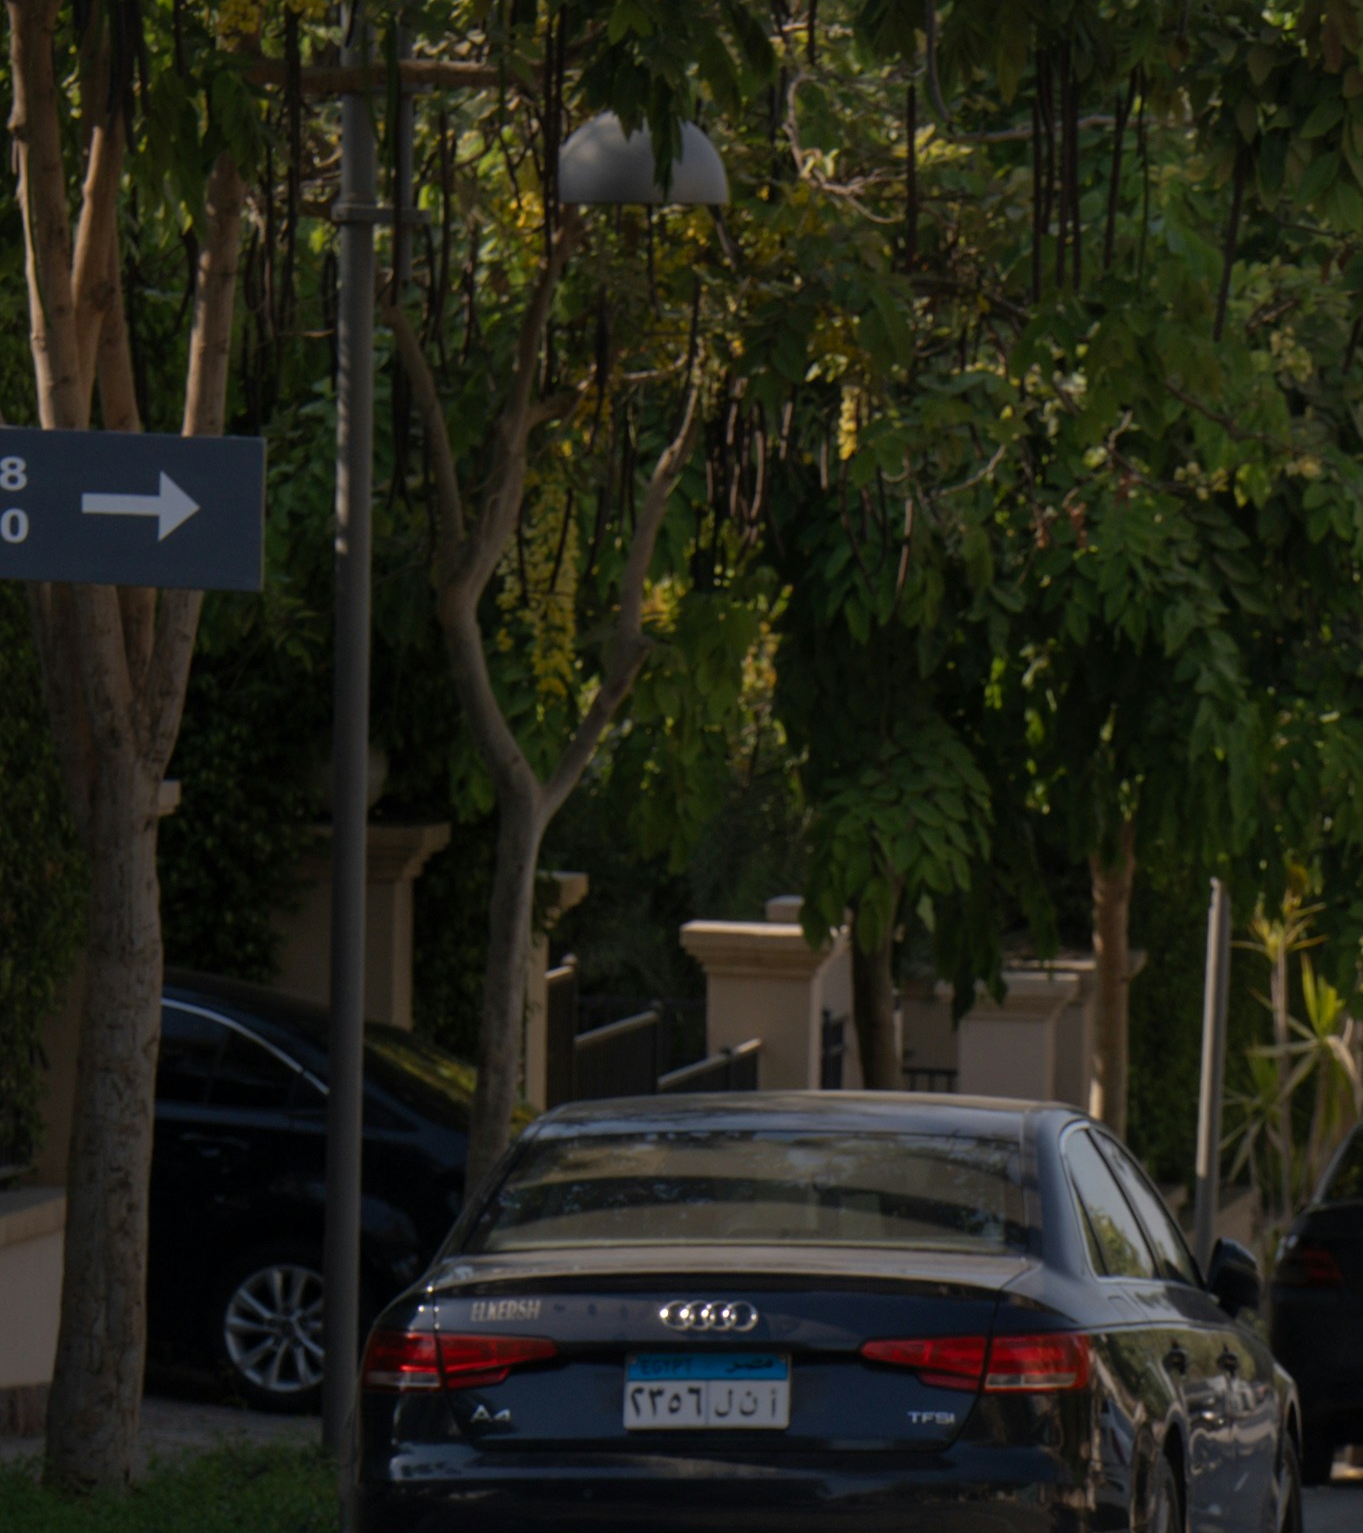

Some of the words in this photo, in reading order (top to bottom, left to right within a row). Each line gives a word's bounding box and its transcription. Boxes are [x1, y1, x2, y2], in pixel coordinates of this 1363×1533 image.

[0, 457, 28, 491] 8
[470, 1404, 511, 1423] A4
[630, 1385, 702, 1417] ٢٣٥٦
